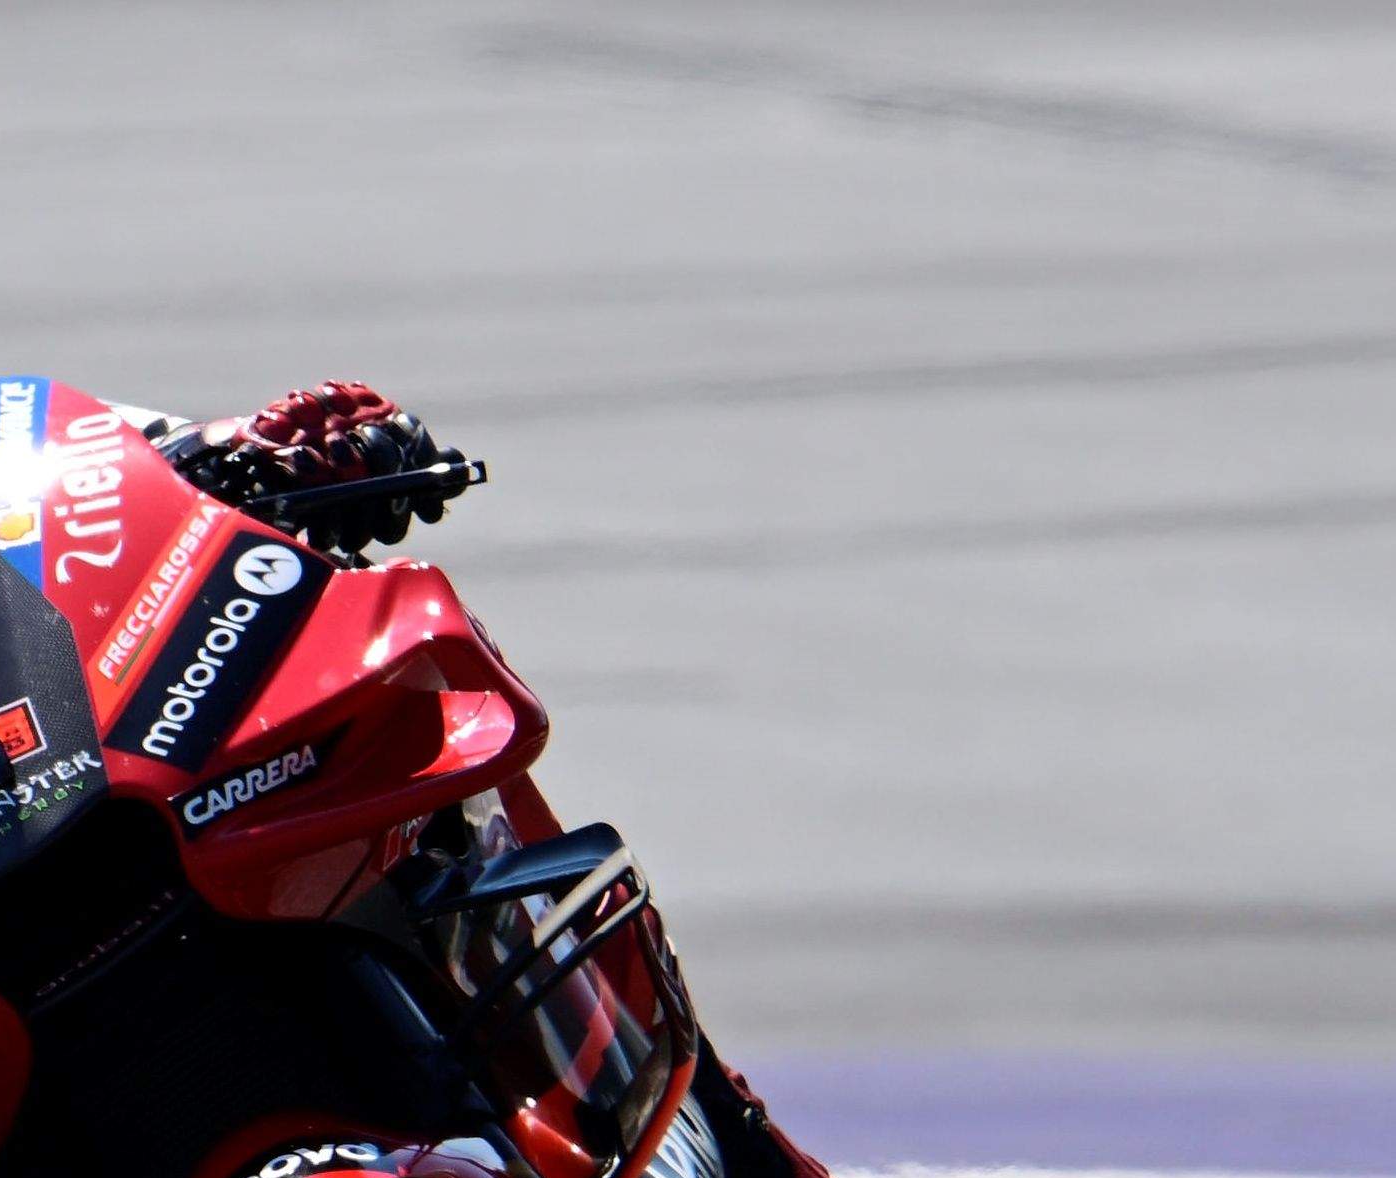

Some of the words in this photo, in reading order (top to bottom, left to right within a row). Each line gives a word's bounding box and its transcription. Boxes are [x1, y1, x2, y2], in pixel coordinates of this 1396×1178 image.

[99, 504, 227, 678] FRECCIAROSSA
[141, 596, 261, 758] motorola
[183, 744, 318, 826] CARRERA
